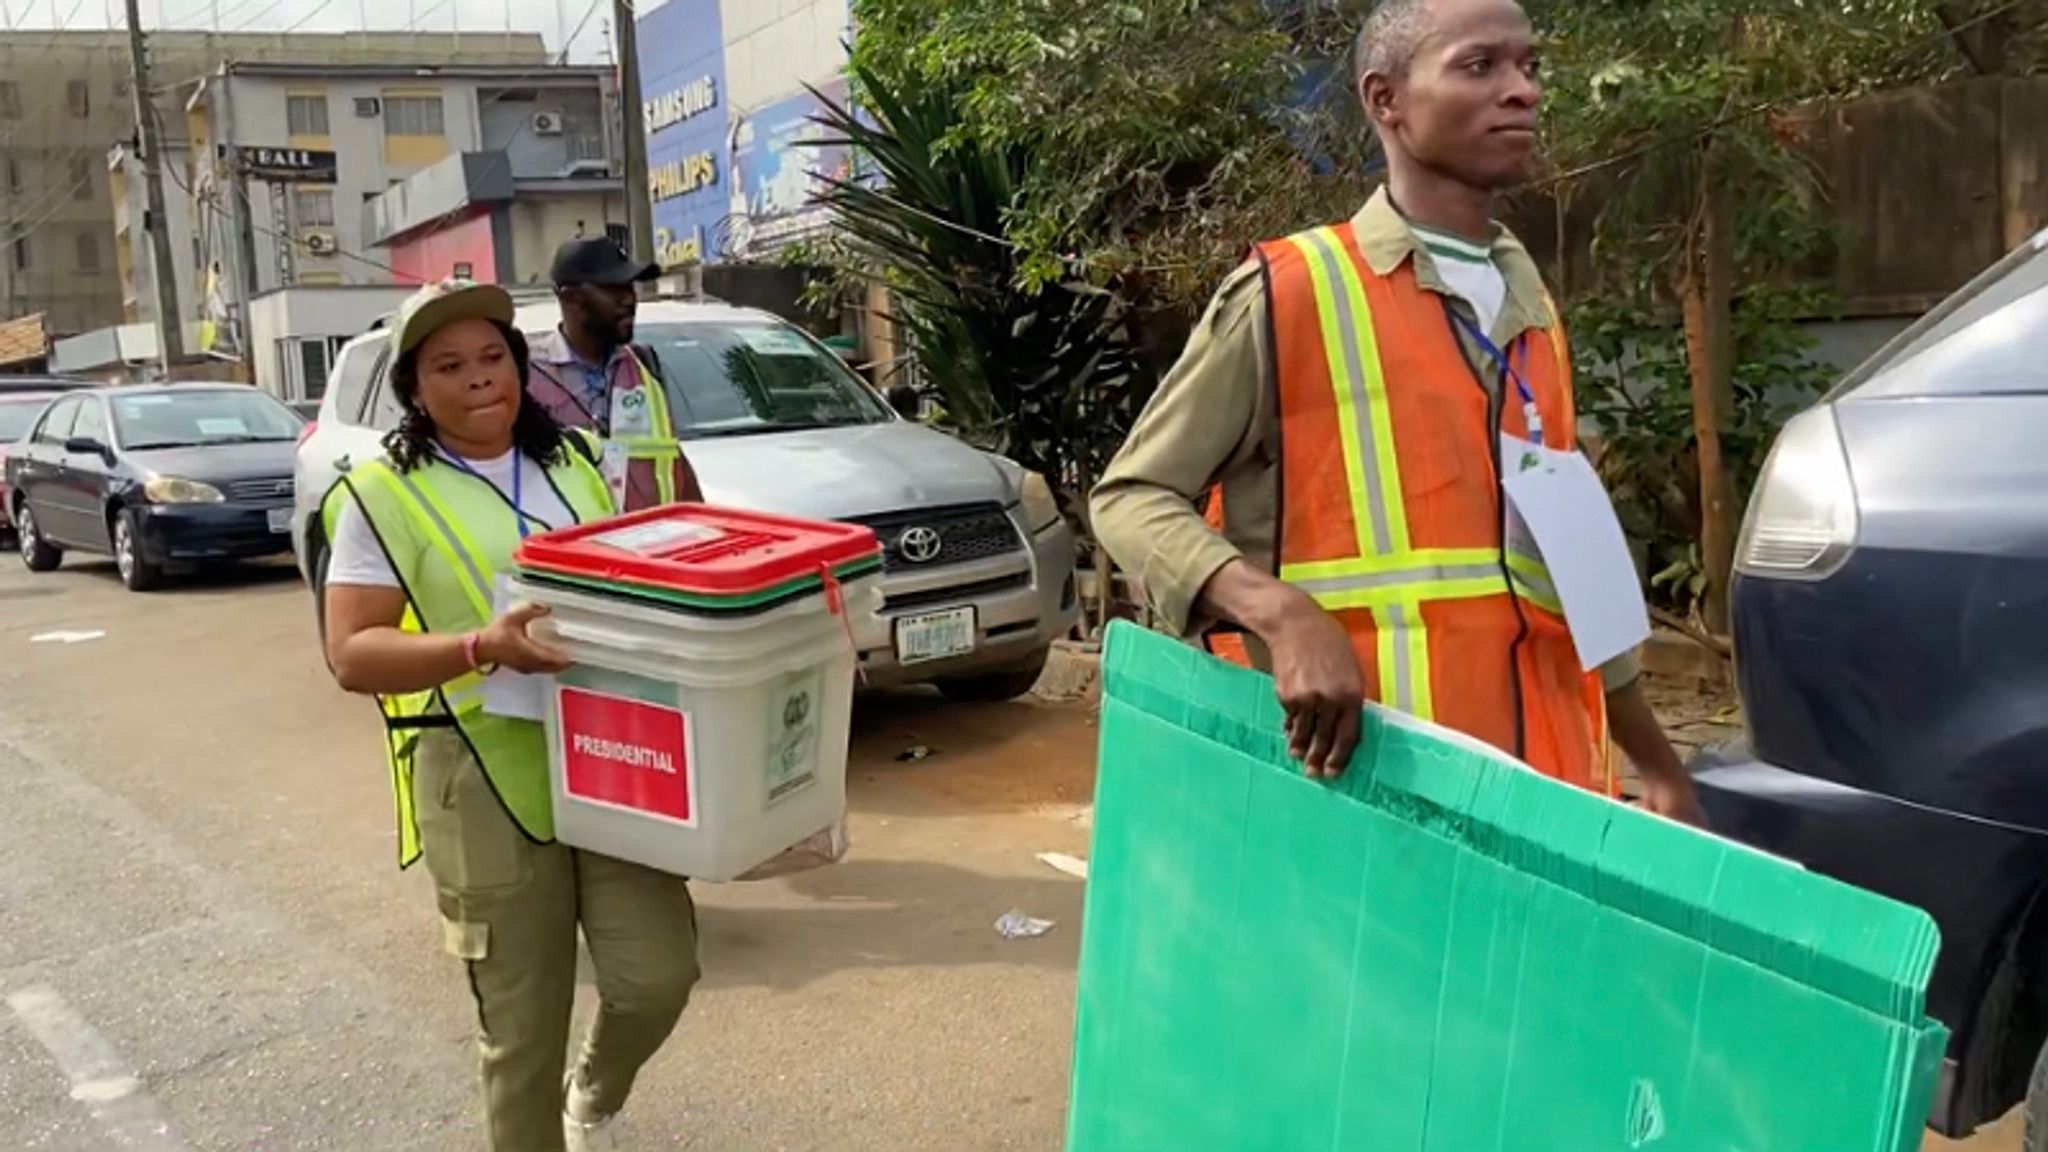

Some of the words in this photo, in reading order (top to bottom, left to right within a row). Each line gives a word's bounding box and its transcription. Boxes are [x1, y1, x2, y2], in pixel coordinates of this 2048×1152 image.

[643, 75, 715, 134] SAMSUNG
[650, 151, 715, 202] PHILIPS
[573, 733, 678, 775] PRESIDENTIAL
